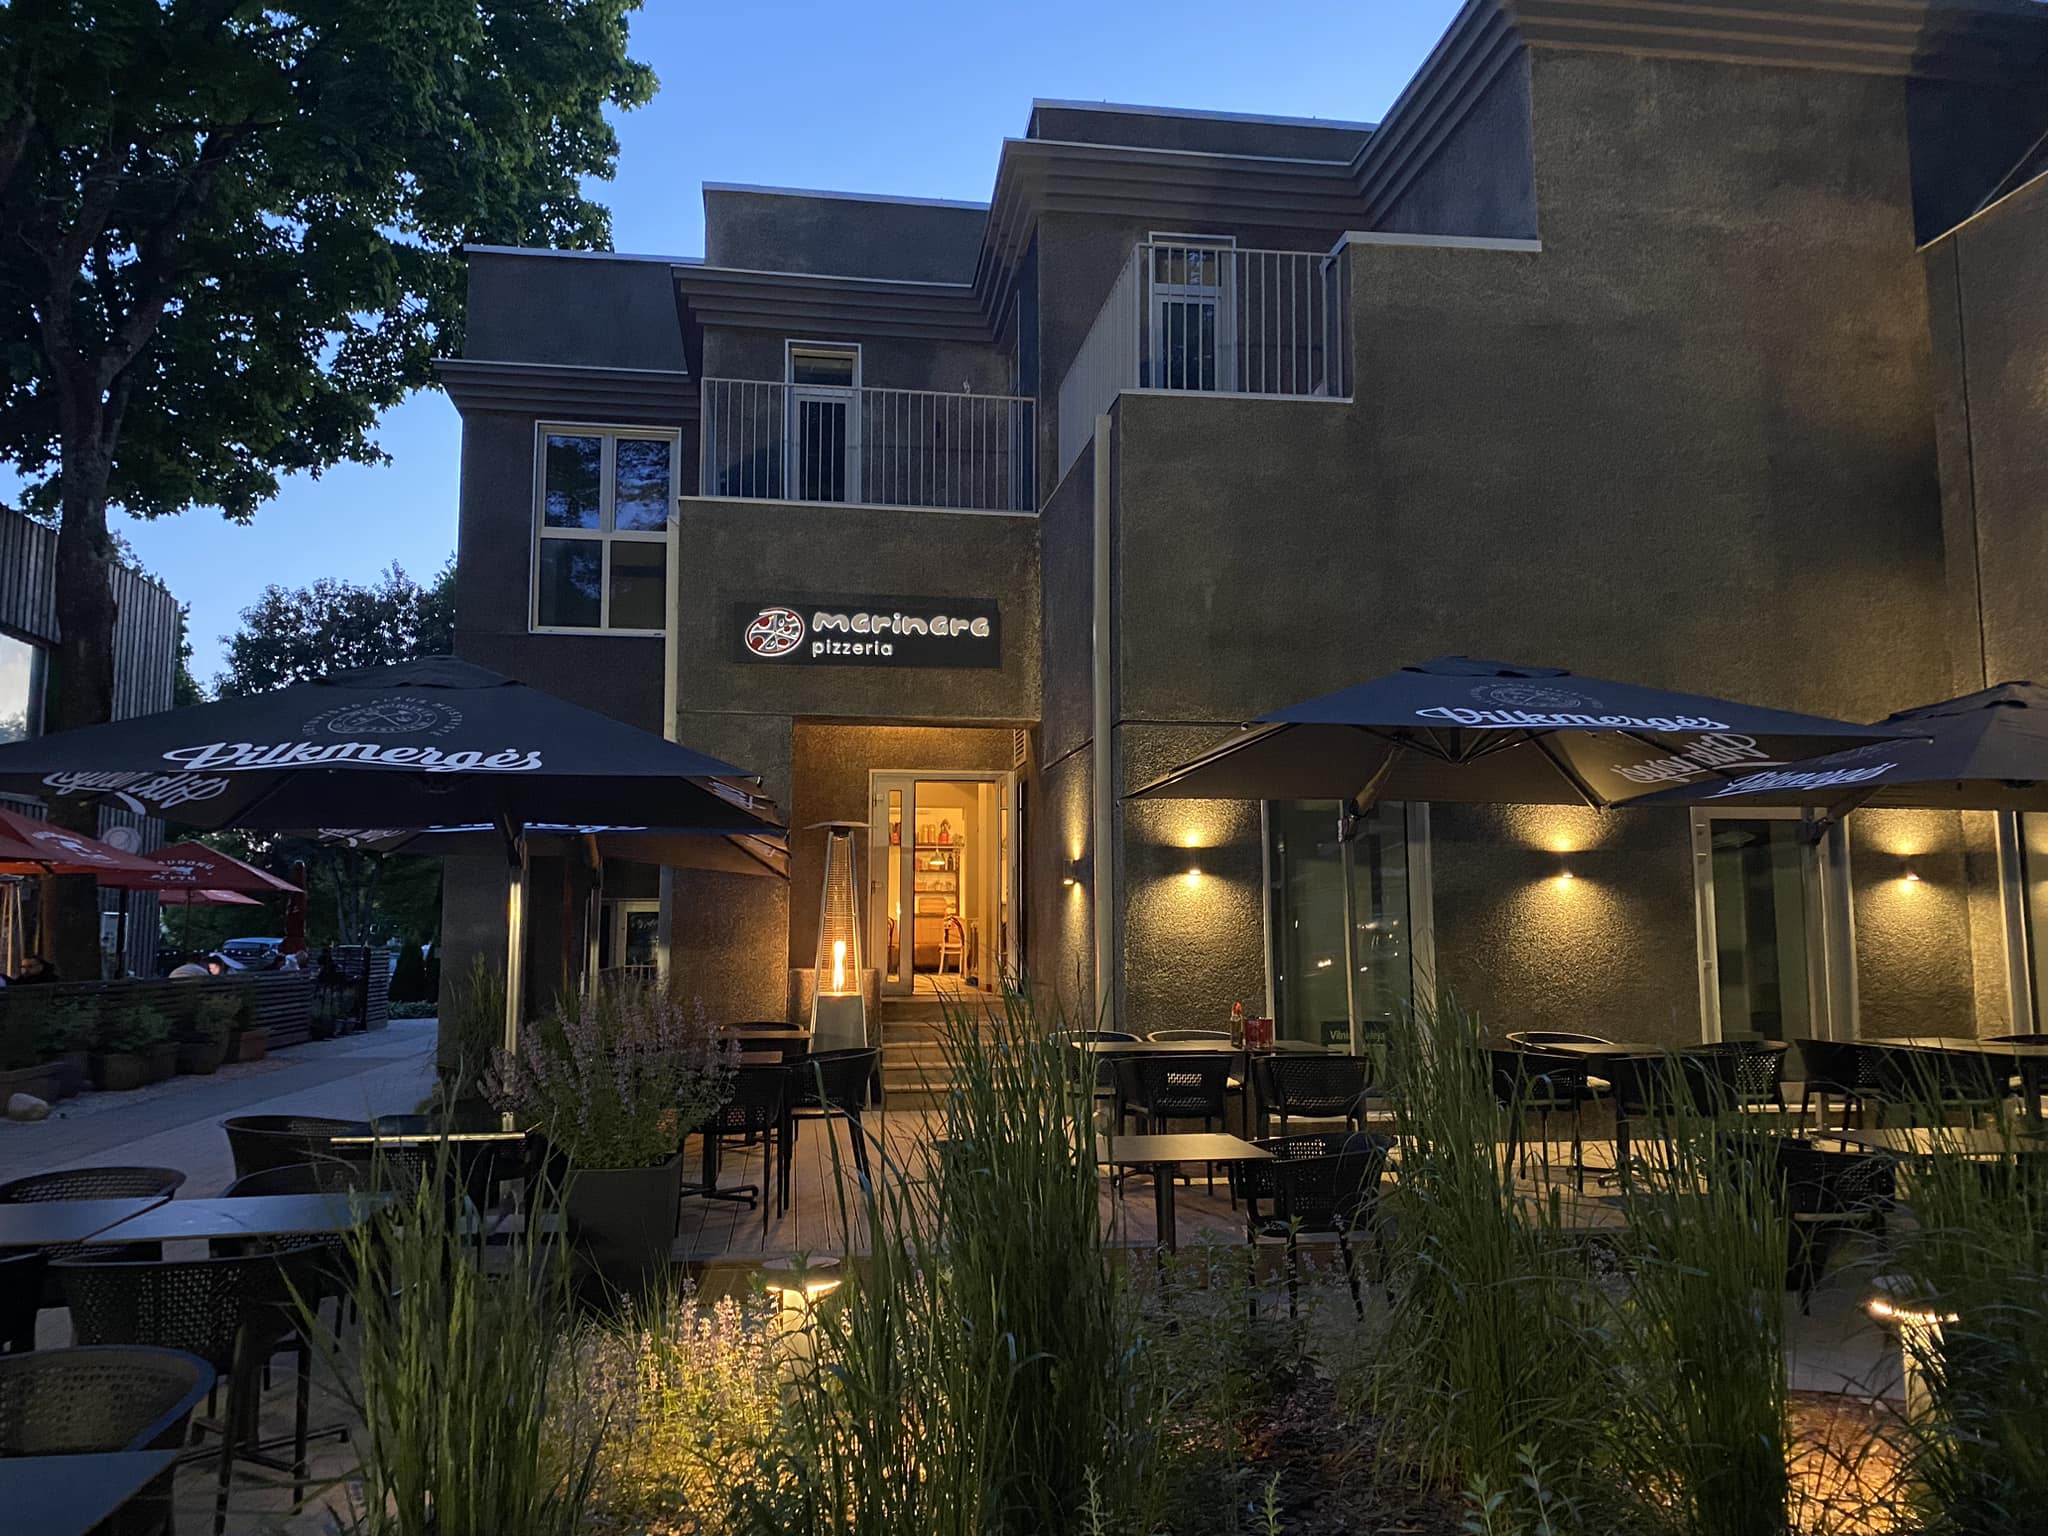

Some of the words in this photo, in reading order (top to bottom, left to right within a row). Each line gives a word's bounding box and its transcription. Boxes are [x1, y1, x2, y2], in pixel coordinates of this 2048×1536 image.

[812, 611, 990, 637] marinara
[812, 639, 894, 658] pizzeria
[1415, 706, 1732, 731] Vilkmergės
[162, 741, 542, 773] Vilkmergės
